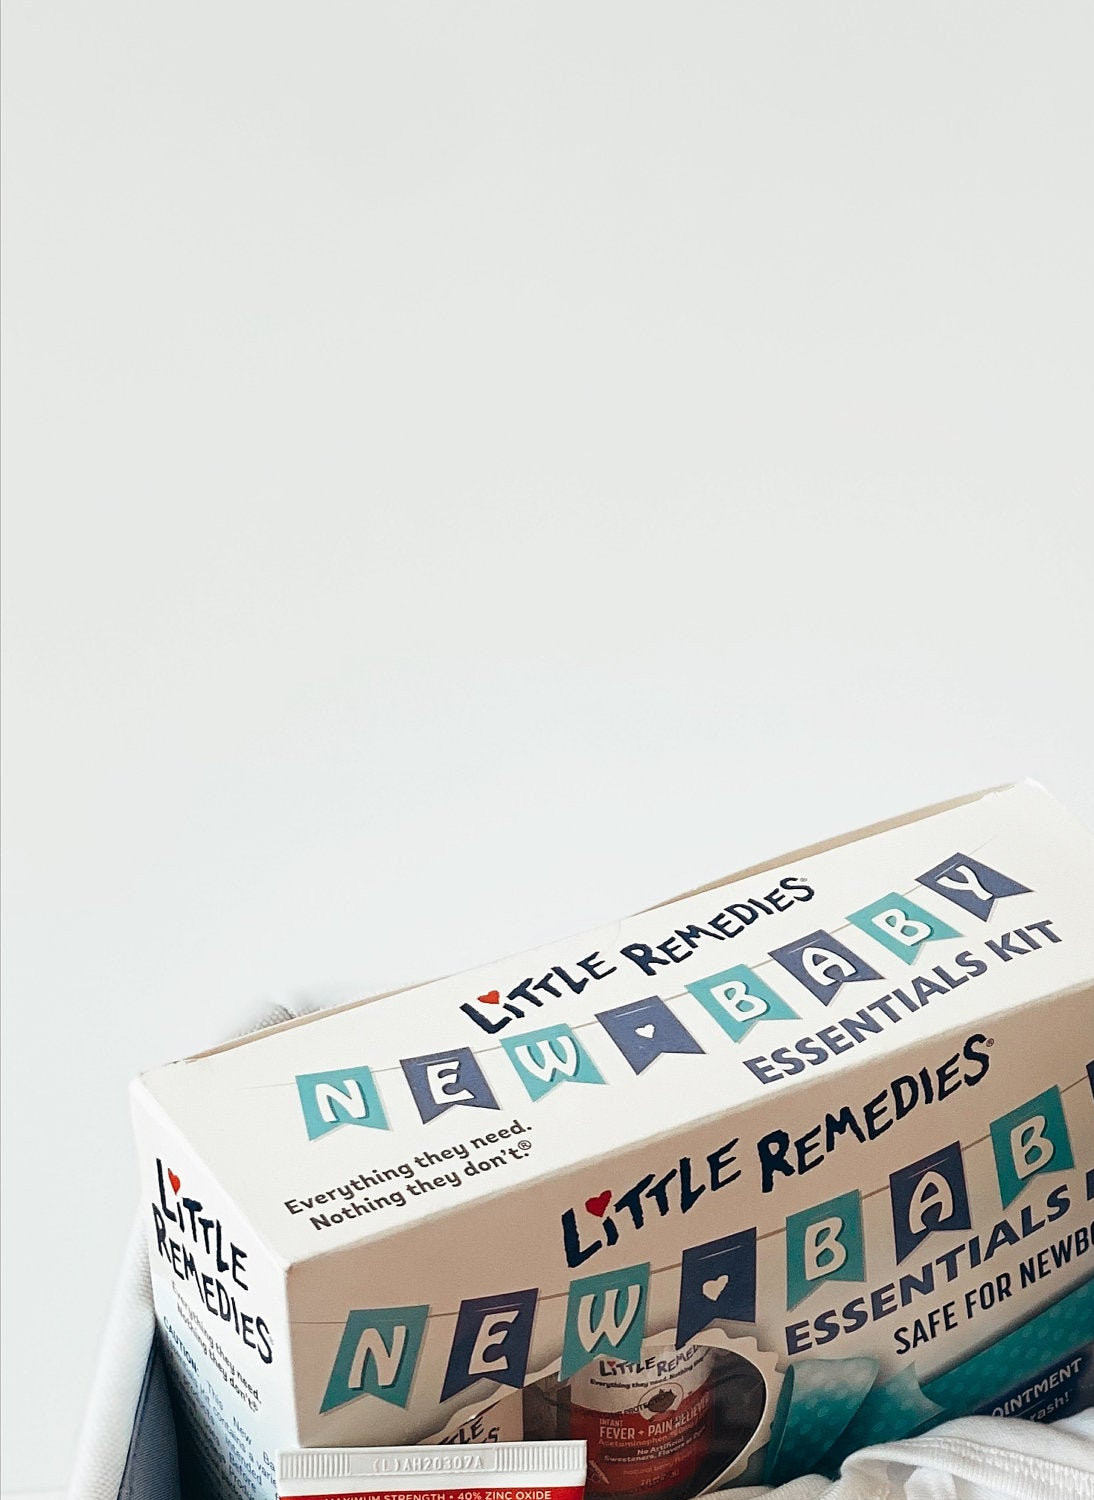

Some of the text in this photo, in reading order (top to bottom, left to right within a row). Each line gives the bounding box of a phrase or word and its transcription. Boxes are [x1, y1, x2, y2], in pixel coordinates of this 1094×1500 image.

[460, 877, 815, 1034] LITTLE REMEDIES
[743, 920, 1062, 1084] ESSENTIALS KIT
[284, 1119, 532, 1215] Everything they need.
[309, 1190, 406, 1230] Nothing
[407, 1170, 462, 1199] they
[561, 1034, 988, 1268] LITTLE REMEDIES
[156, 1158, 248, 1291] LITTLE
[785, 1185, 1071, 1355] ESSENTIALS
[152, 1203, 272, 1364] REMEDIES
[894, 1301, 957, 1354] SAFE
[966, 1272, 1012, 1319] FOR
[600, 1427, 635, 1440] FEVER
[648, 1420, 673, 1437] PAIN
[992, 1358, 1082, 1417] OINTMENT
[457, 1491, 482, 1500] 40%
[485, 1491, 513, 1500] ZINC
[515, 1490, 552, 1500] OXIDE
